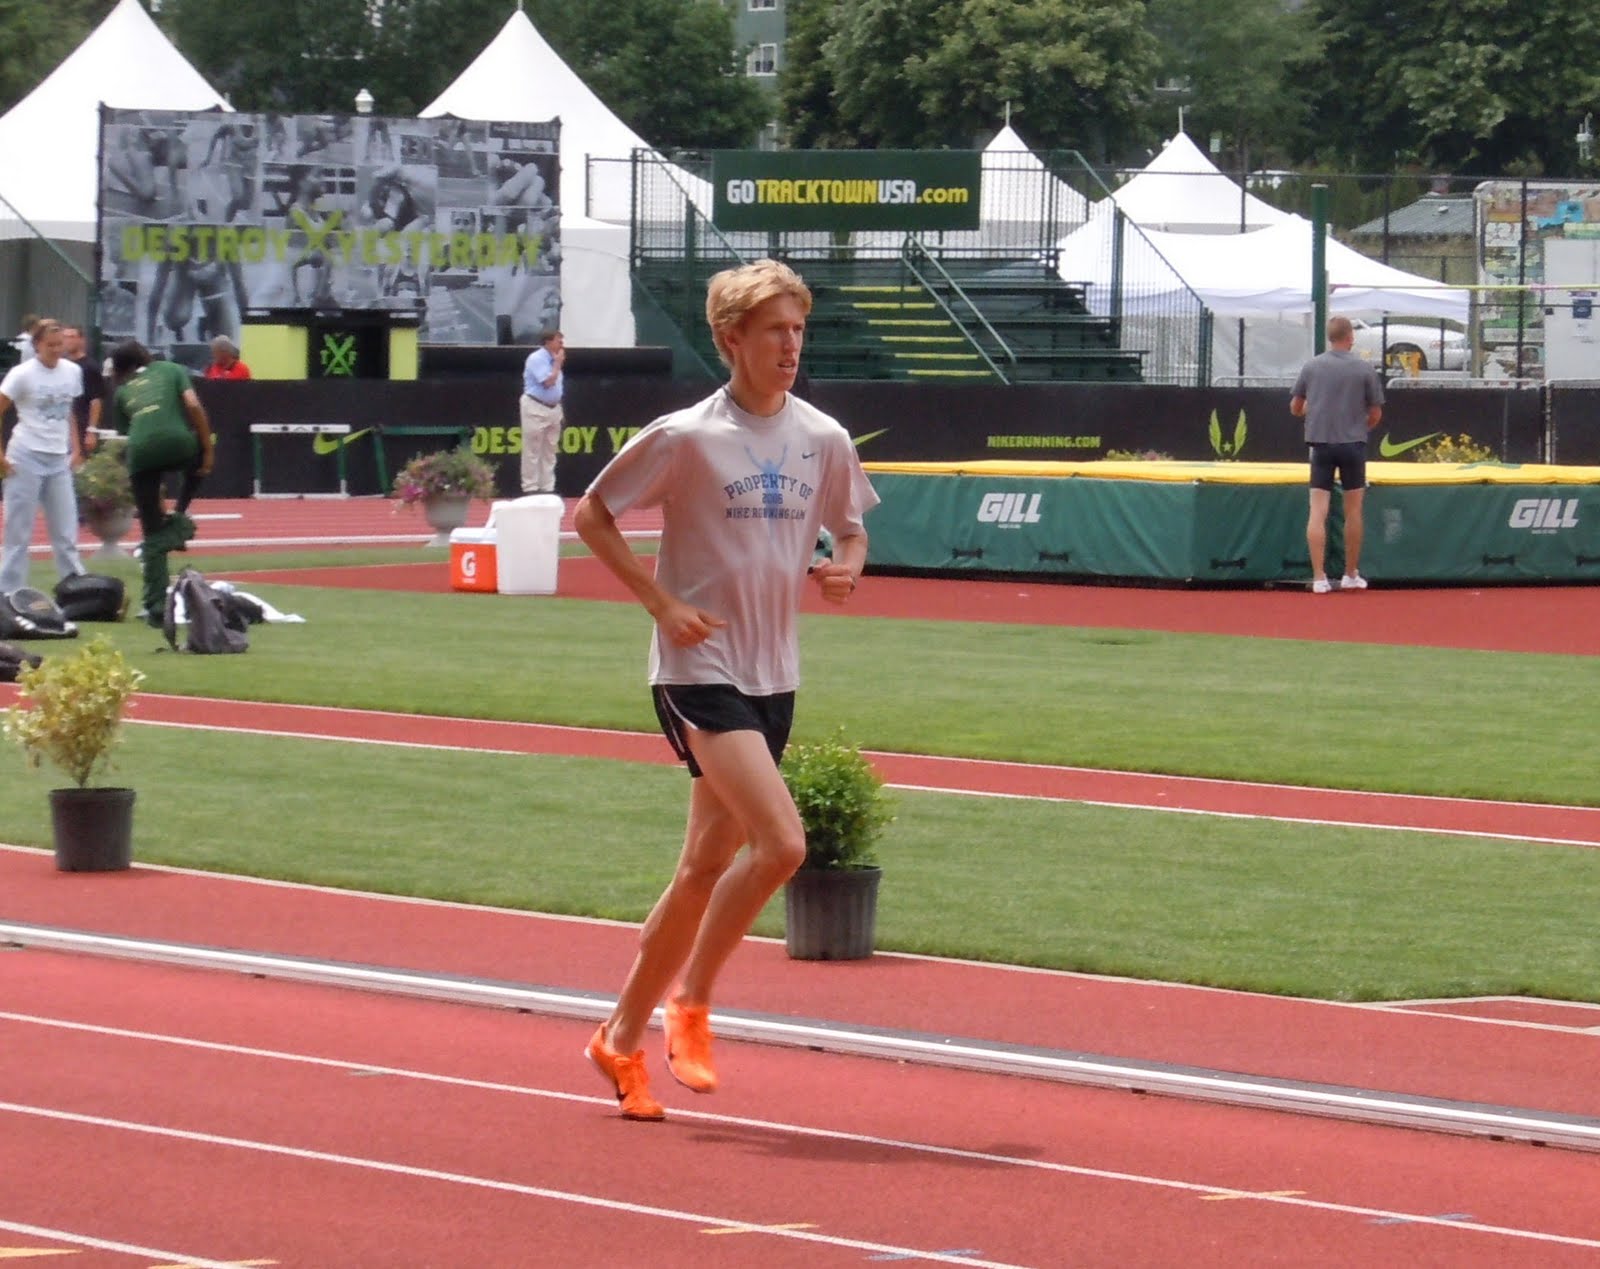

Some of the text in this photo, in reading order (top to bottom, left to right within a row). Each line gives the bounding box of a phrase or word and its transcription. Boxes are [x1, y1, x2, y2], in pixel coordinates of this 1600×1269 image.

[121, 226, 289, 262] DESTROY
[337, 229, 541, 268] YESTERDAY
[472, 426, 598, 454] DESOY
[987, 435, 1101, 448] NIKERUNNING.COM
[724, 473, 814, 501] PROPERTY OF
[726, 507, 750, 519] NIKE
[751, 507, 790, 520] RUNNING
[977, 492, 1042, 523] GILL
[1508, 498, 1579, 528] GILL
[461, 551, 476, 577] G
